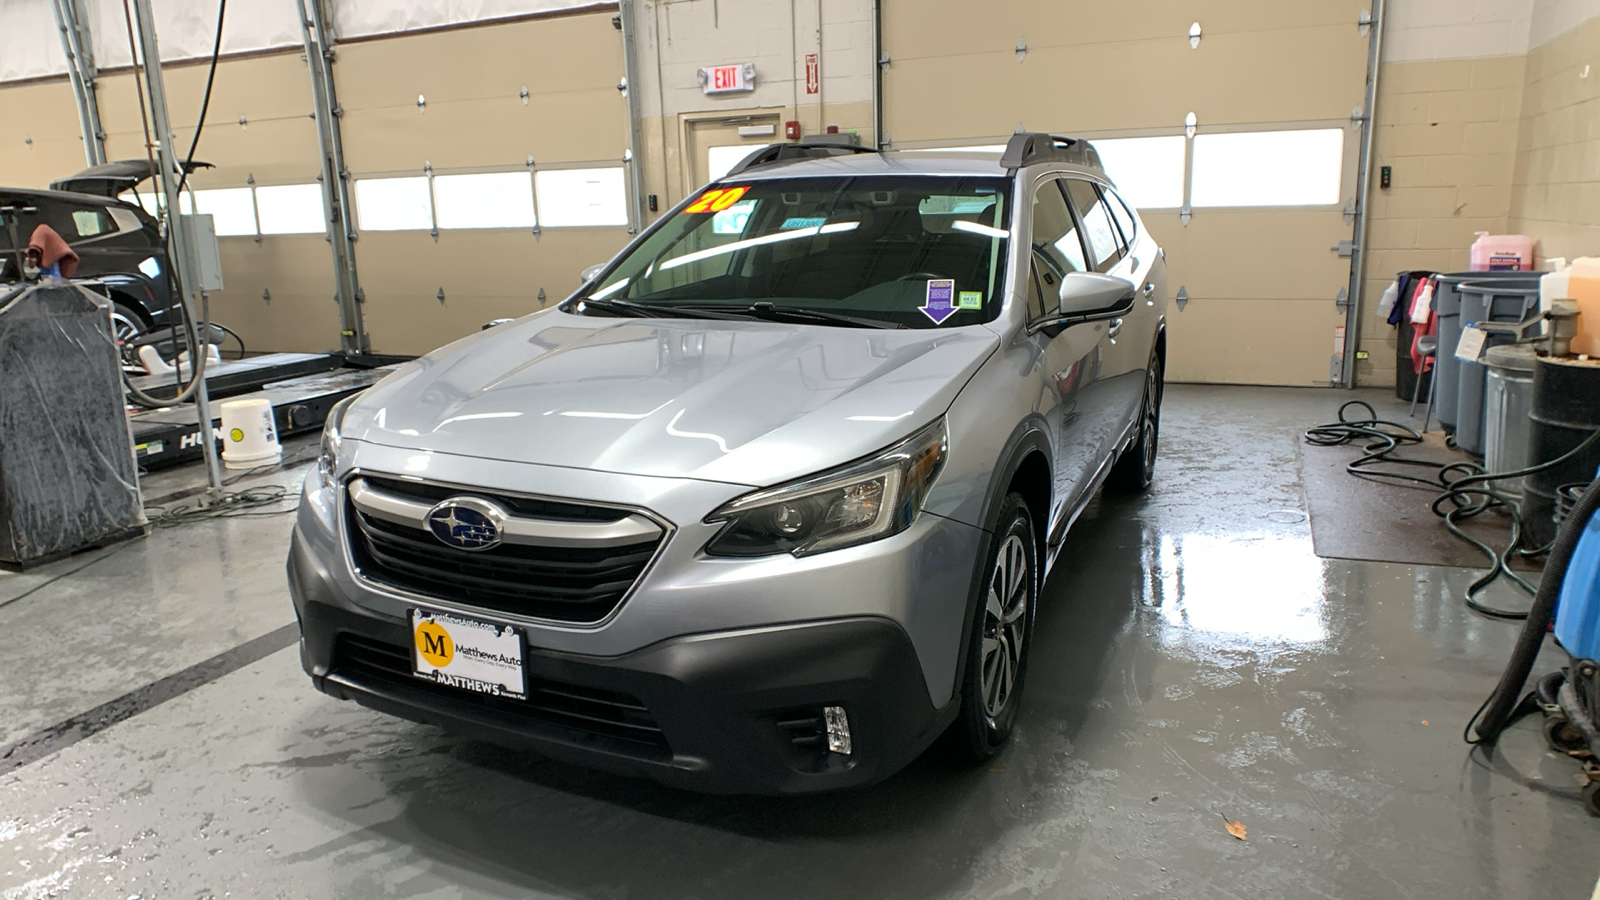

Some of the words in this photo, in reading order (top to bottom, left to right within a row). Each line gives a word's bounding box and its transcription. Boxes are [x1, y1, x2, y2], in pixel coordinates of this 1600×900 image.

[714, 67, 737, 90] EXIT
[686, 187, 745, 213] 20
[430, 612, 496, 632] MatthewsAuto.com
[422, 631, 448, 658] M
[455, 643, 498, 662] Matthews
[498, 653, 522, 667] Auto
[437, 673, 500, 696] MATTHEWS
